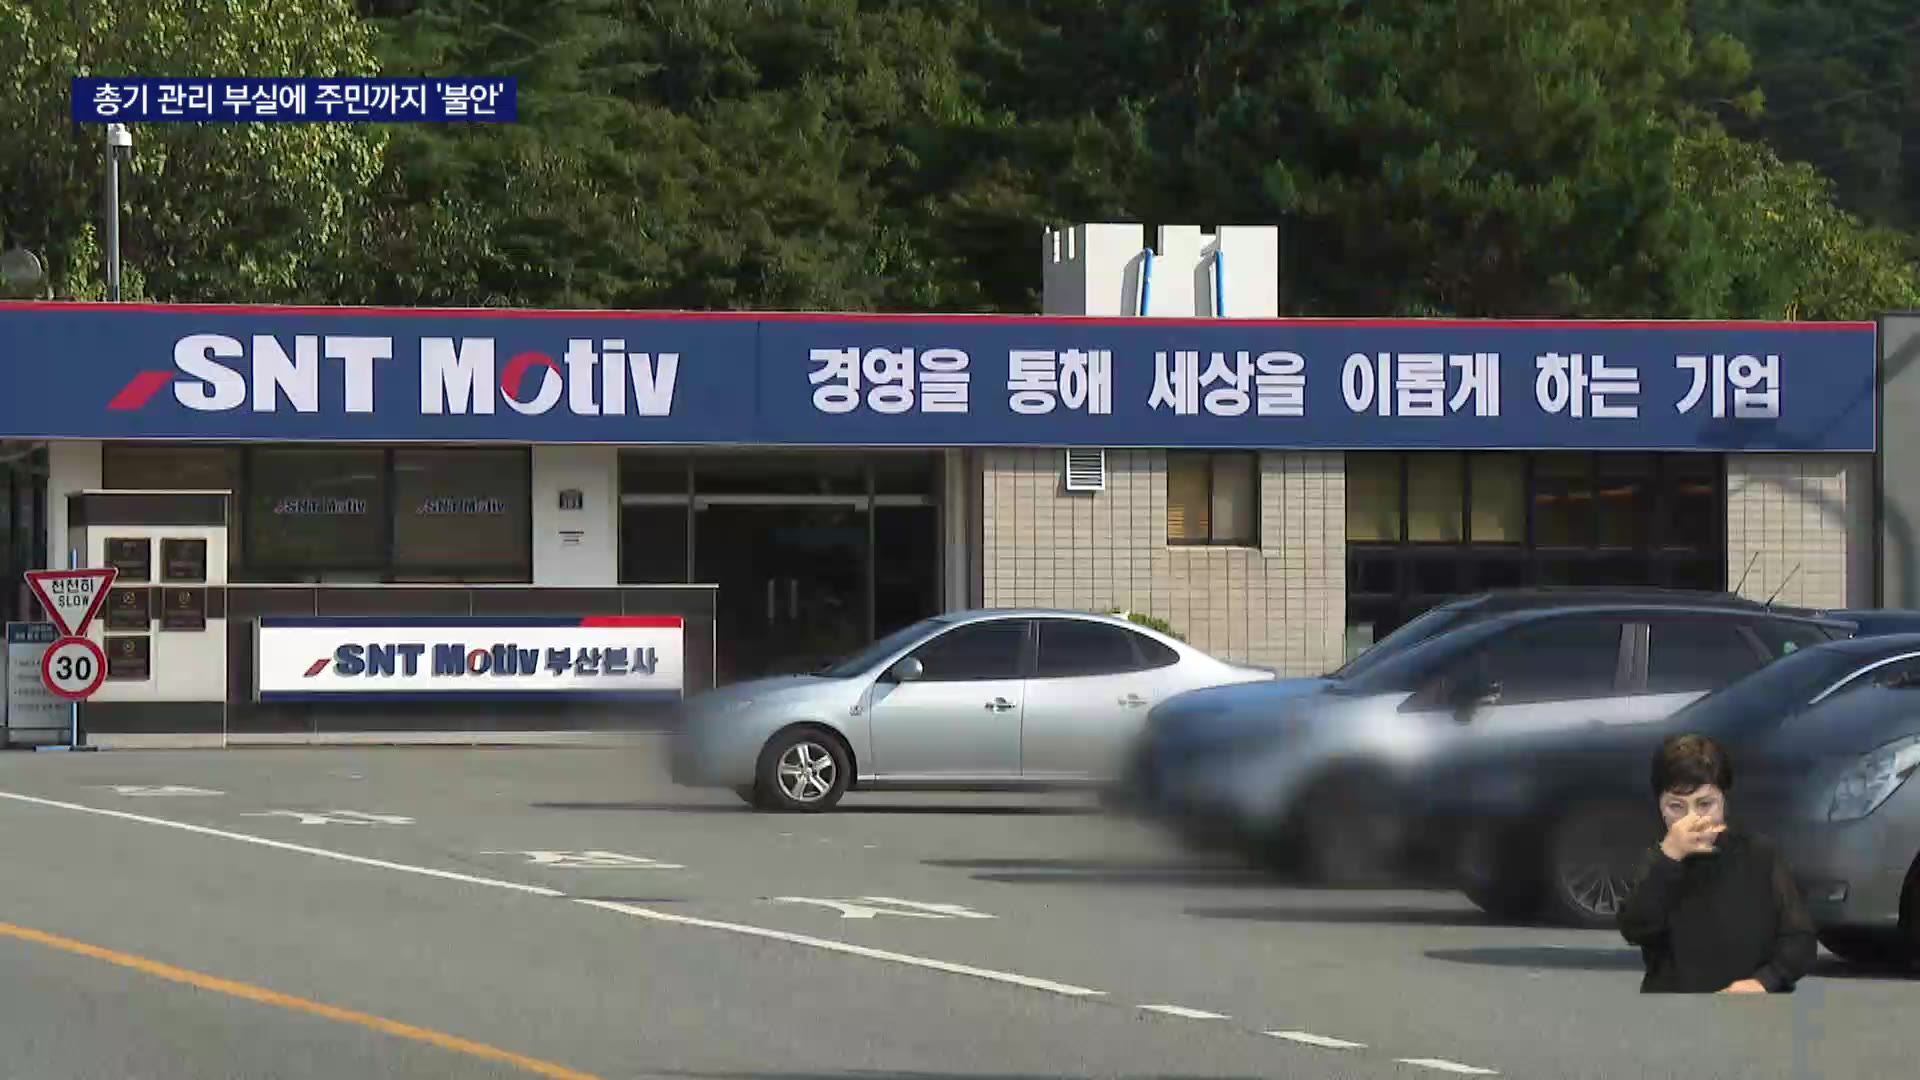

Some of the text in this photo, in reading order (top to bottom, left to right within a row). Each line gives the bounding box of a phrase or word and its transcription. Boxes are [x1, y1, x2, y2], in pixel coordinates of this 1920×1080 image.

[173, 334, 680, 416] SNT Motiv
[808, 347, 1779, 418] 경영을 통해 세상을 이롭게 하는 기업
[52, 578, 94, 594] 천천히
[58, 595, 90, 608] SLOW
[56, 656, 92, 681] 30
[333, 643, 659, 678] SNT Motiv 부산본사
